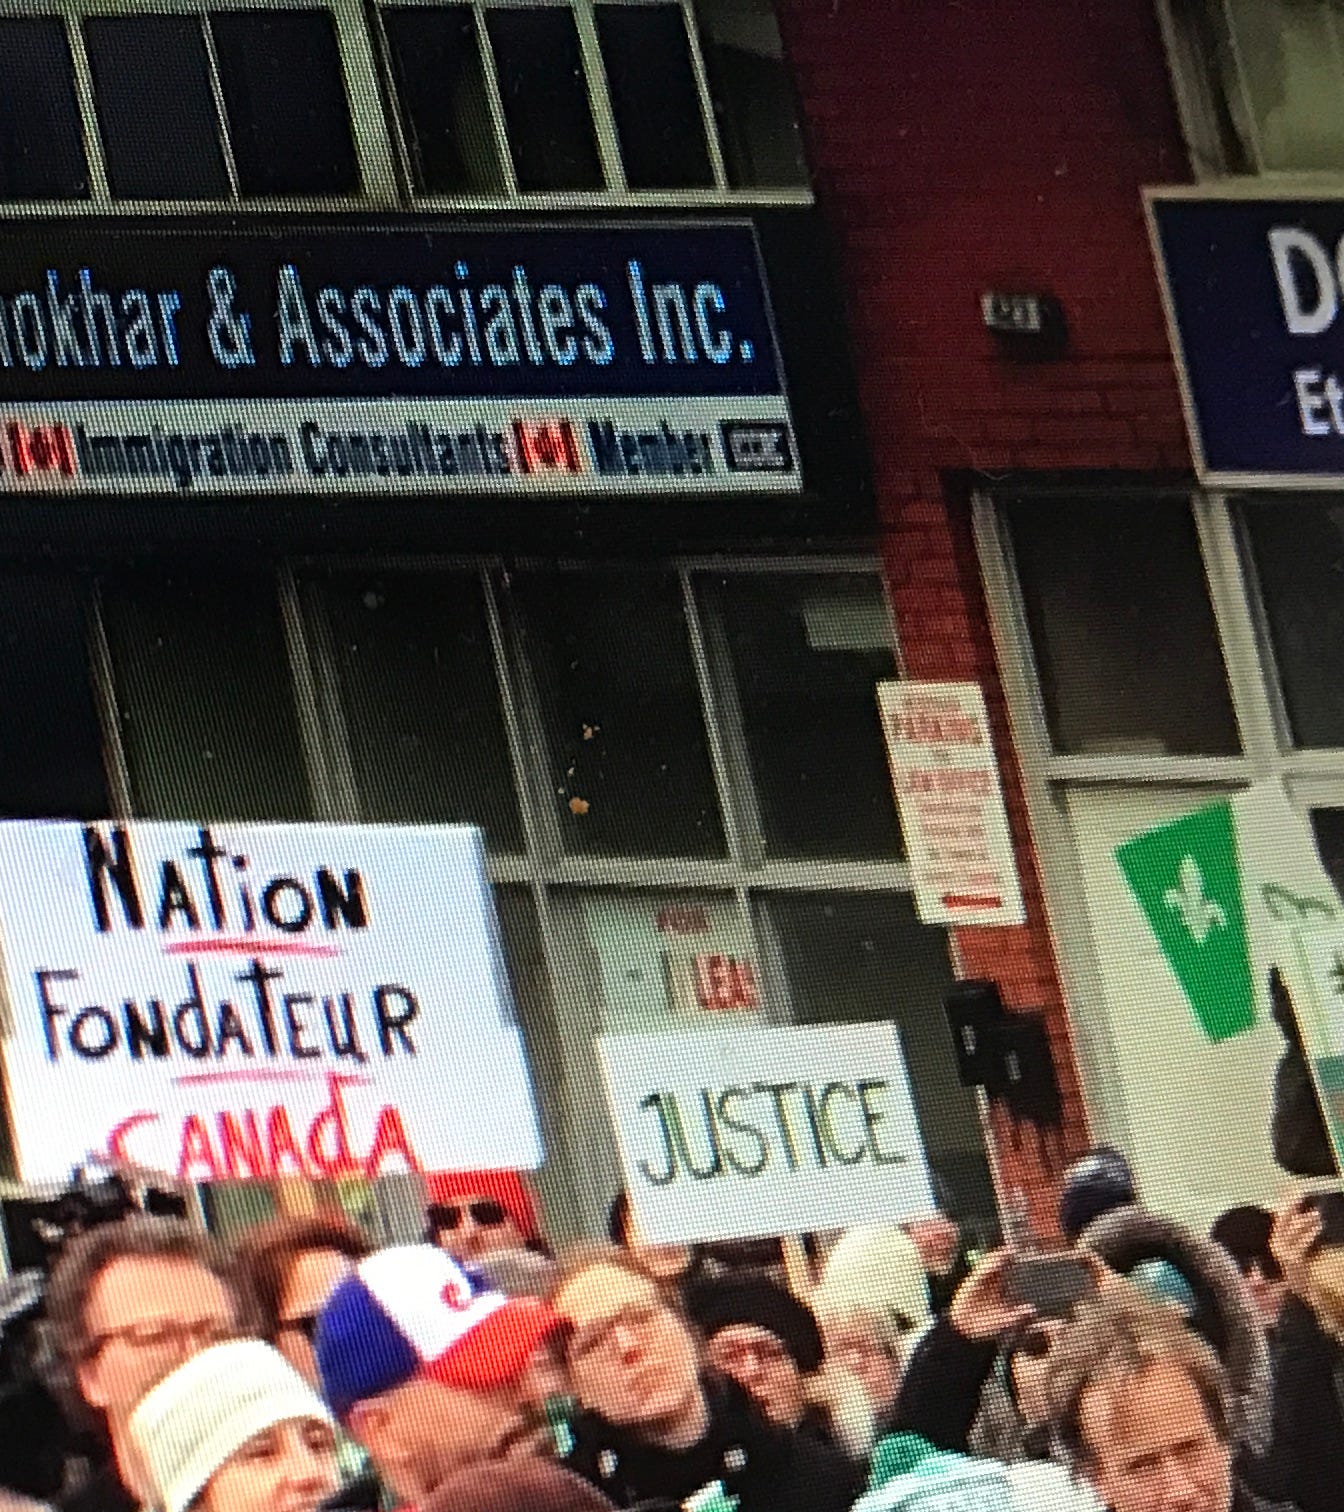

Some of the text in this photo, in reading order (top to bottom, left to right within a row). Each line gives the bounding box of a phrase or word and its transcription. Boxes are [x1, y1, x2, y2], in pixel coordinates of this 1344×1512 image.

[207, 264, 256, 369] &
[277, 259, 617, 369] Associates
[626, 258, 755, 366] Inc.
[78, 421, 292, 488] Immigration
[299, 419, 512, 477] Consultants
[587, 418, 713, 476] Member
[636, 1077, 908, 1186] JUSTICE
